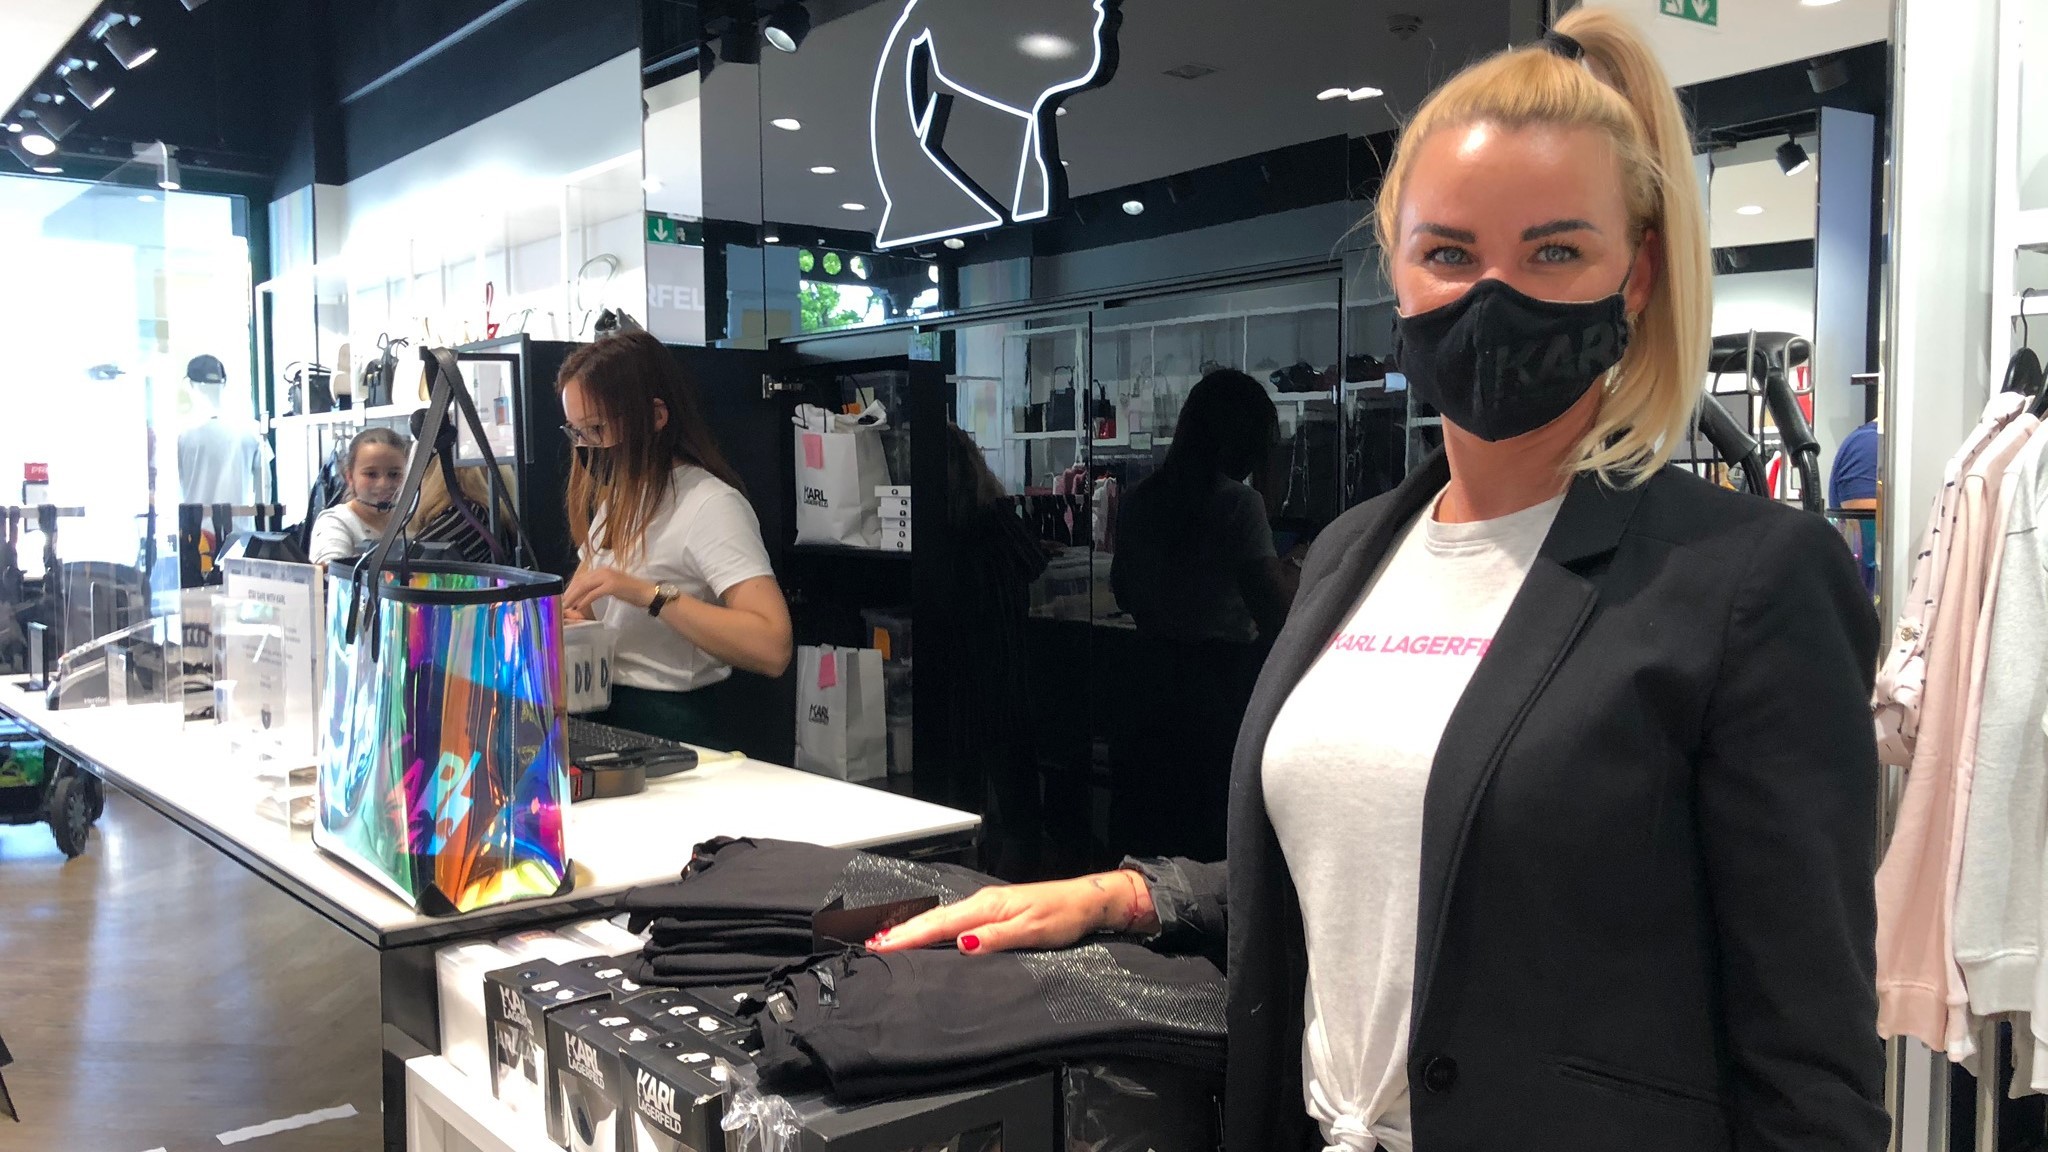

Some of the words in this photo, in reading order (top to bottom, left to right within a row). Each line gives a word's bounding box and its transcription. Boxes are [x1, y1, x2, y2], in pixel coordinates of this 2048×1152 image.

[804, 485, 827, 501] KARL
[1328, 633, 1376, 651] KARL
[564, 1031, 603, 1079] KARL
[568, 1059, 605, 1090] LAGERFELD
[637, 1067, 681, 1121] KARL
[638, 1096, 682, 1135] LAGERFELD
